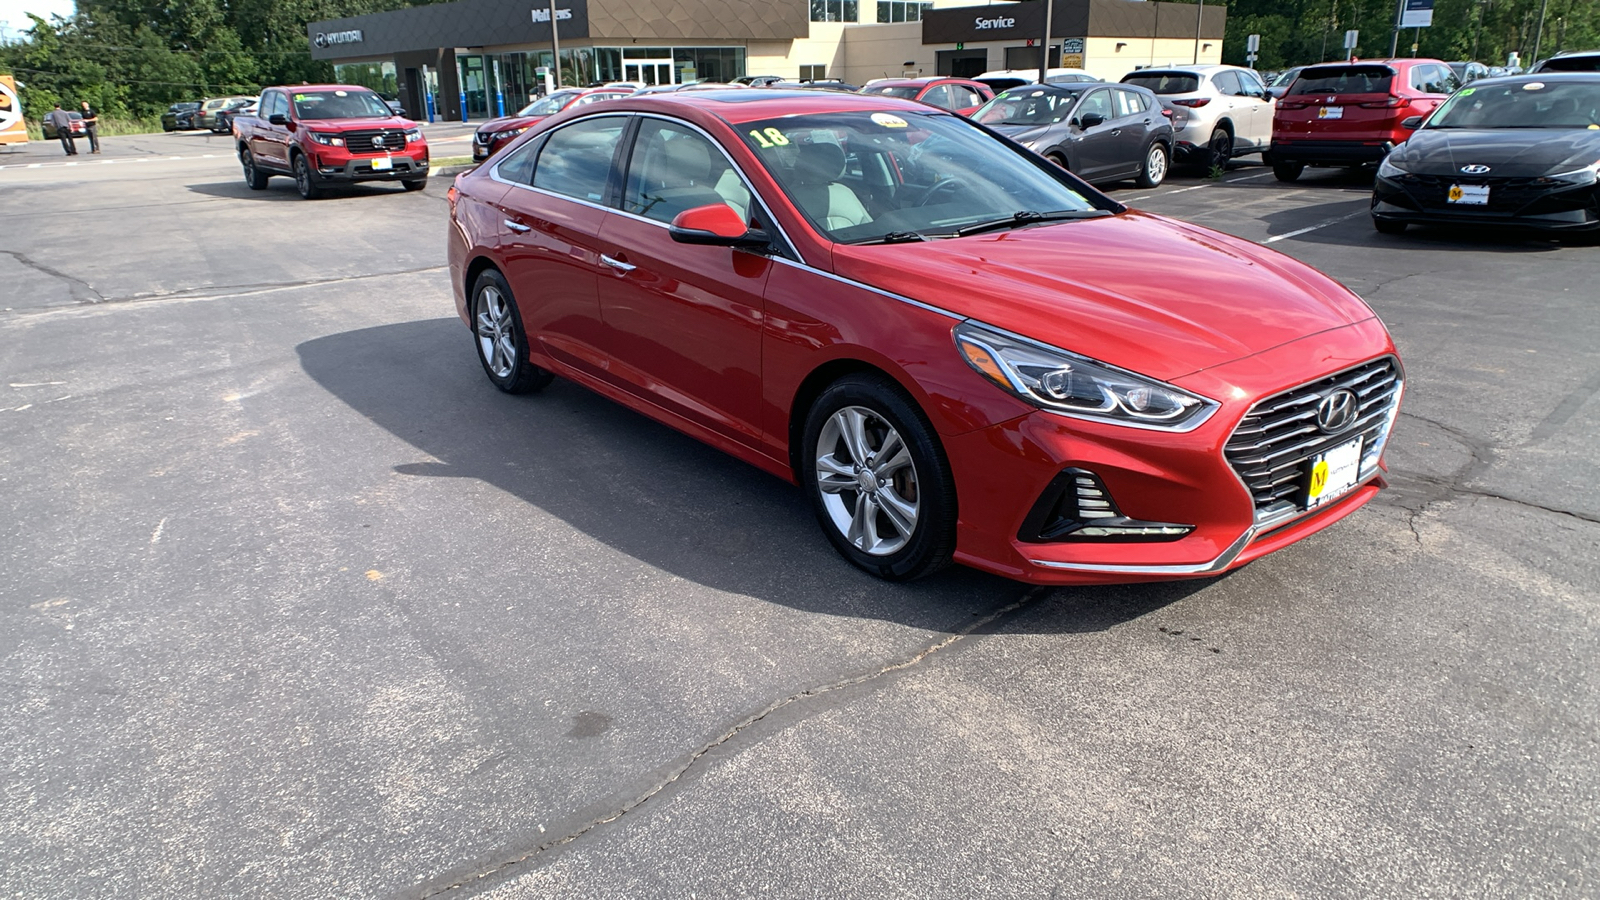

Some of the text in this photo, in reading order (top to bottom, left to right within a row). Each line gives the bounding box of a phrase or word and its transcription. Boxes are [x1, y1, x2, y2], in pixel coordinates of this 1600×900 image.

[975, 16, 1015, 29] Service
[327, 30, 362, 44] HYUNDAI
[750, 127, 790, 148] 18
[1313, 469, 1327, 490] M
